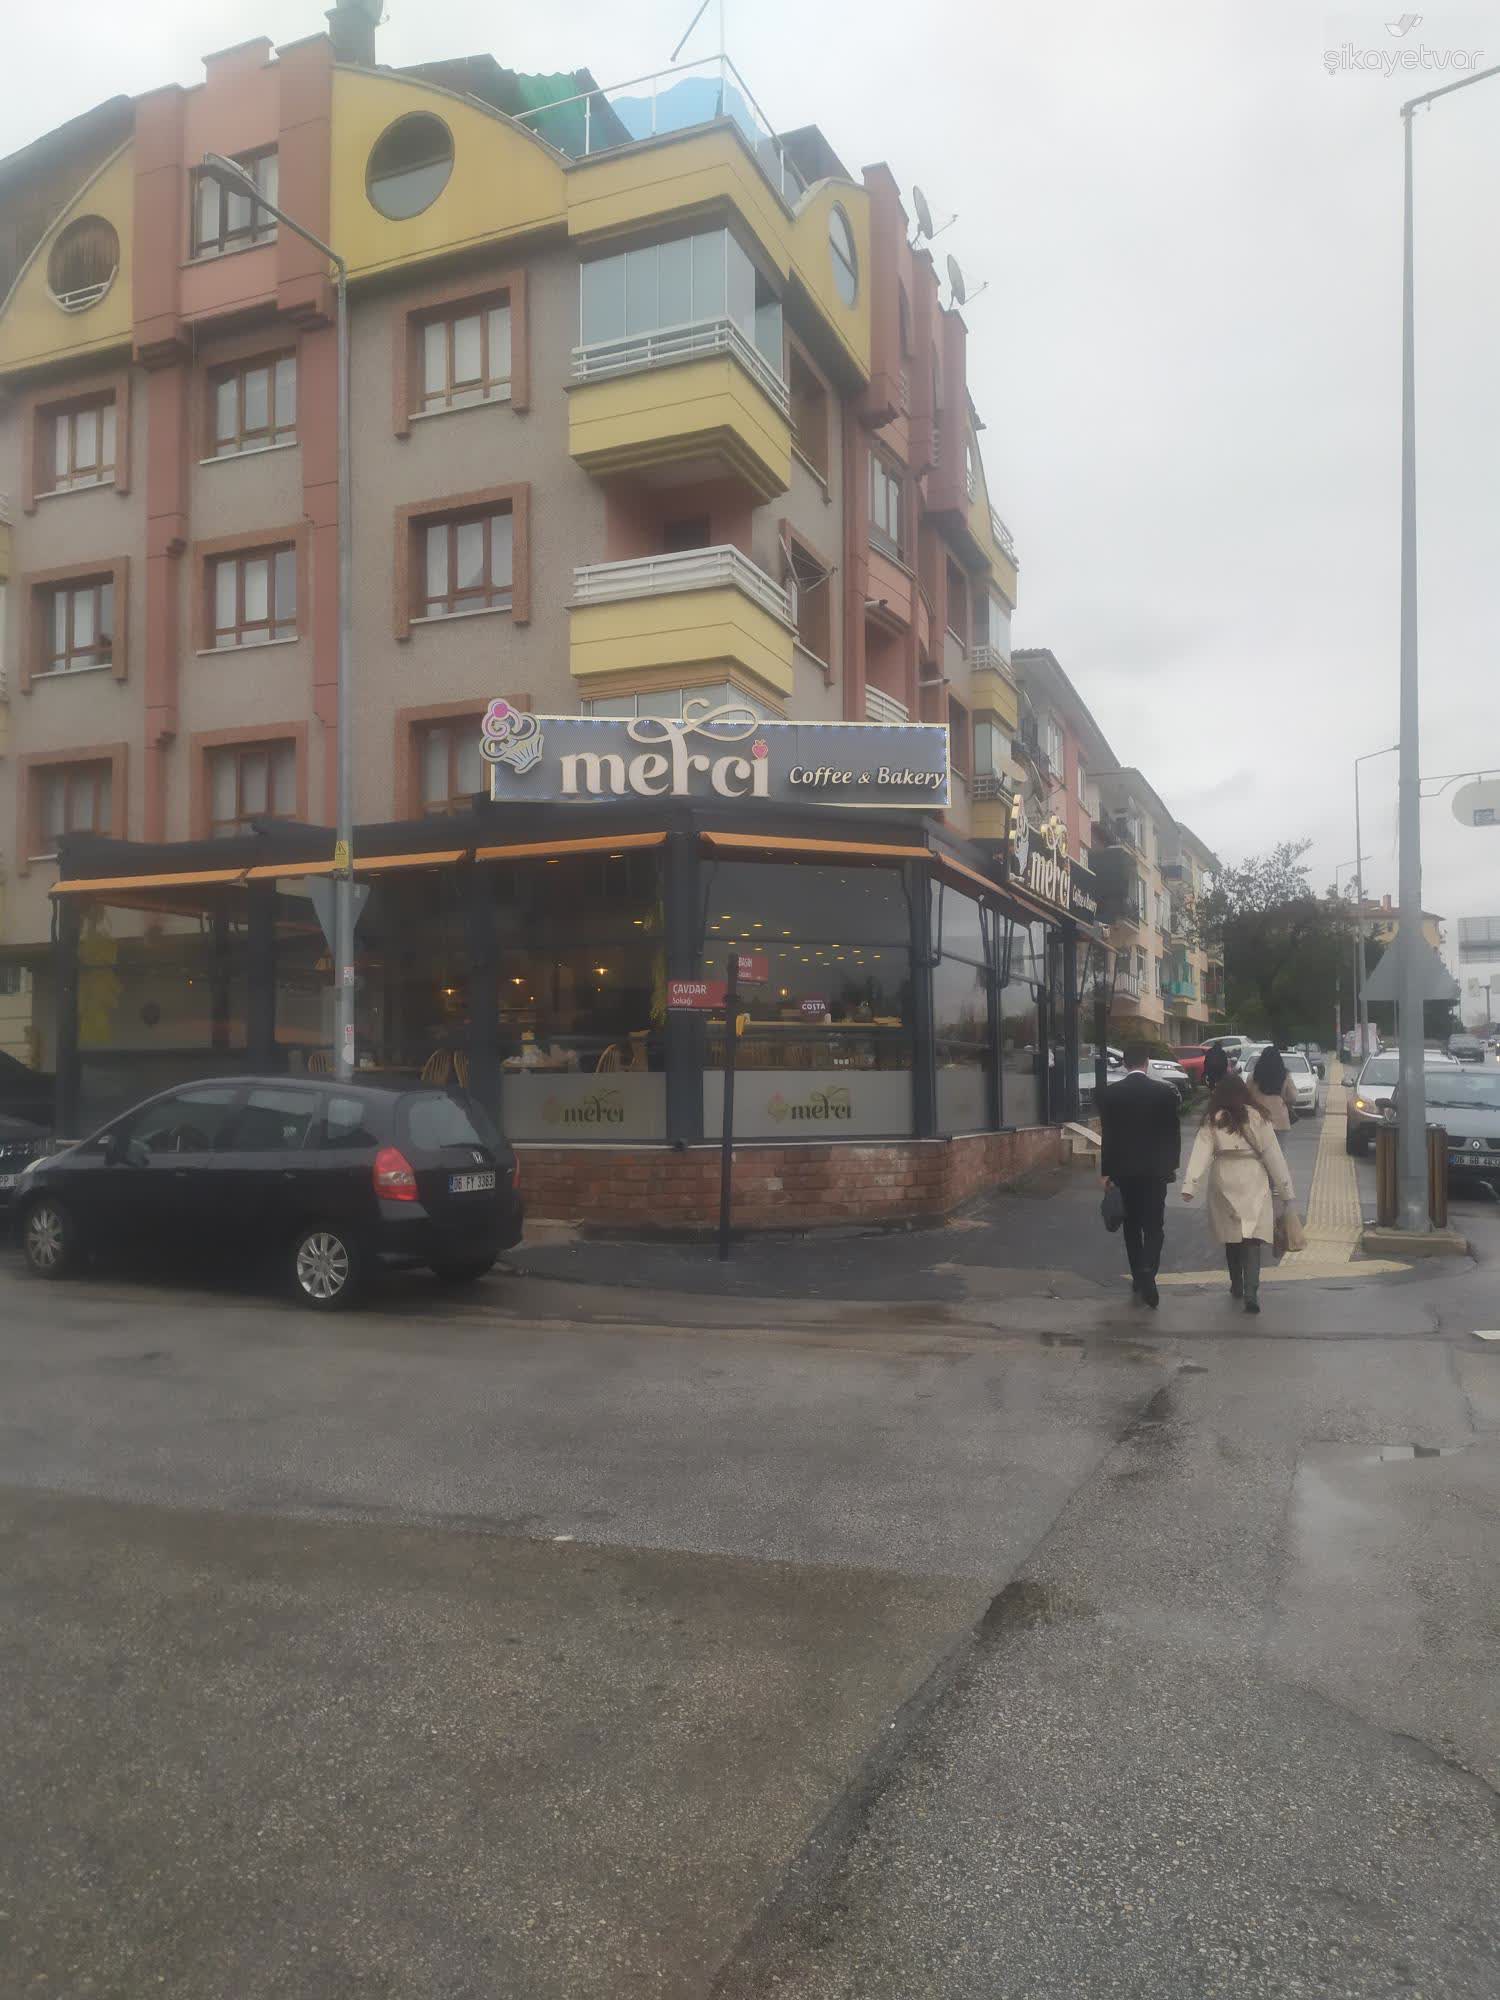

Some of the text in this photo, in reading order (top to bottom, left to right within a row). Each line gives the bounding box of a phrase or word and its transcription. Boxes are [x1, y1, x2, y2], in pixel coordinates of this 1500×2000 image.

[560, 698, 770, 798] merci
[789, 766, 945, 789] Coffee & Bakery
[672, 983, 707, 995] ÇAVDAR
[802, 1003, 826, 1011] COSTA
